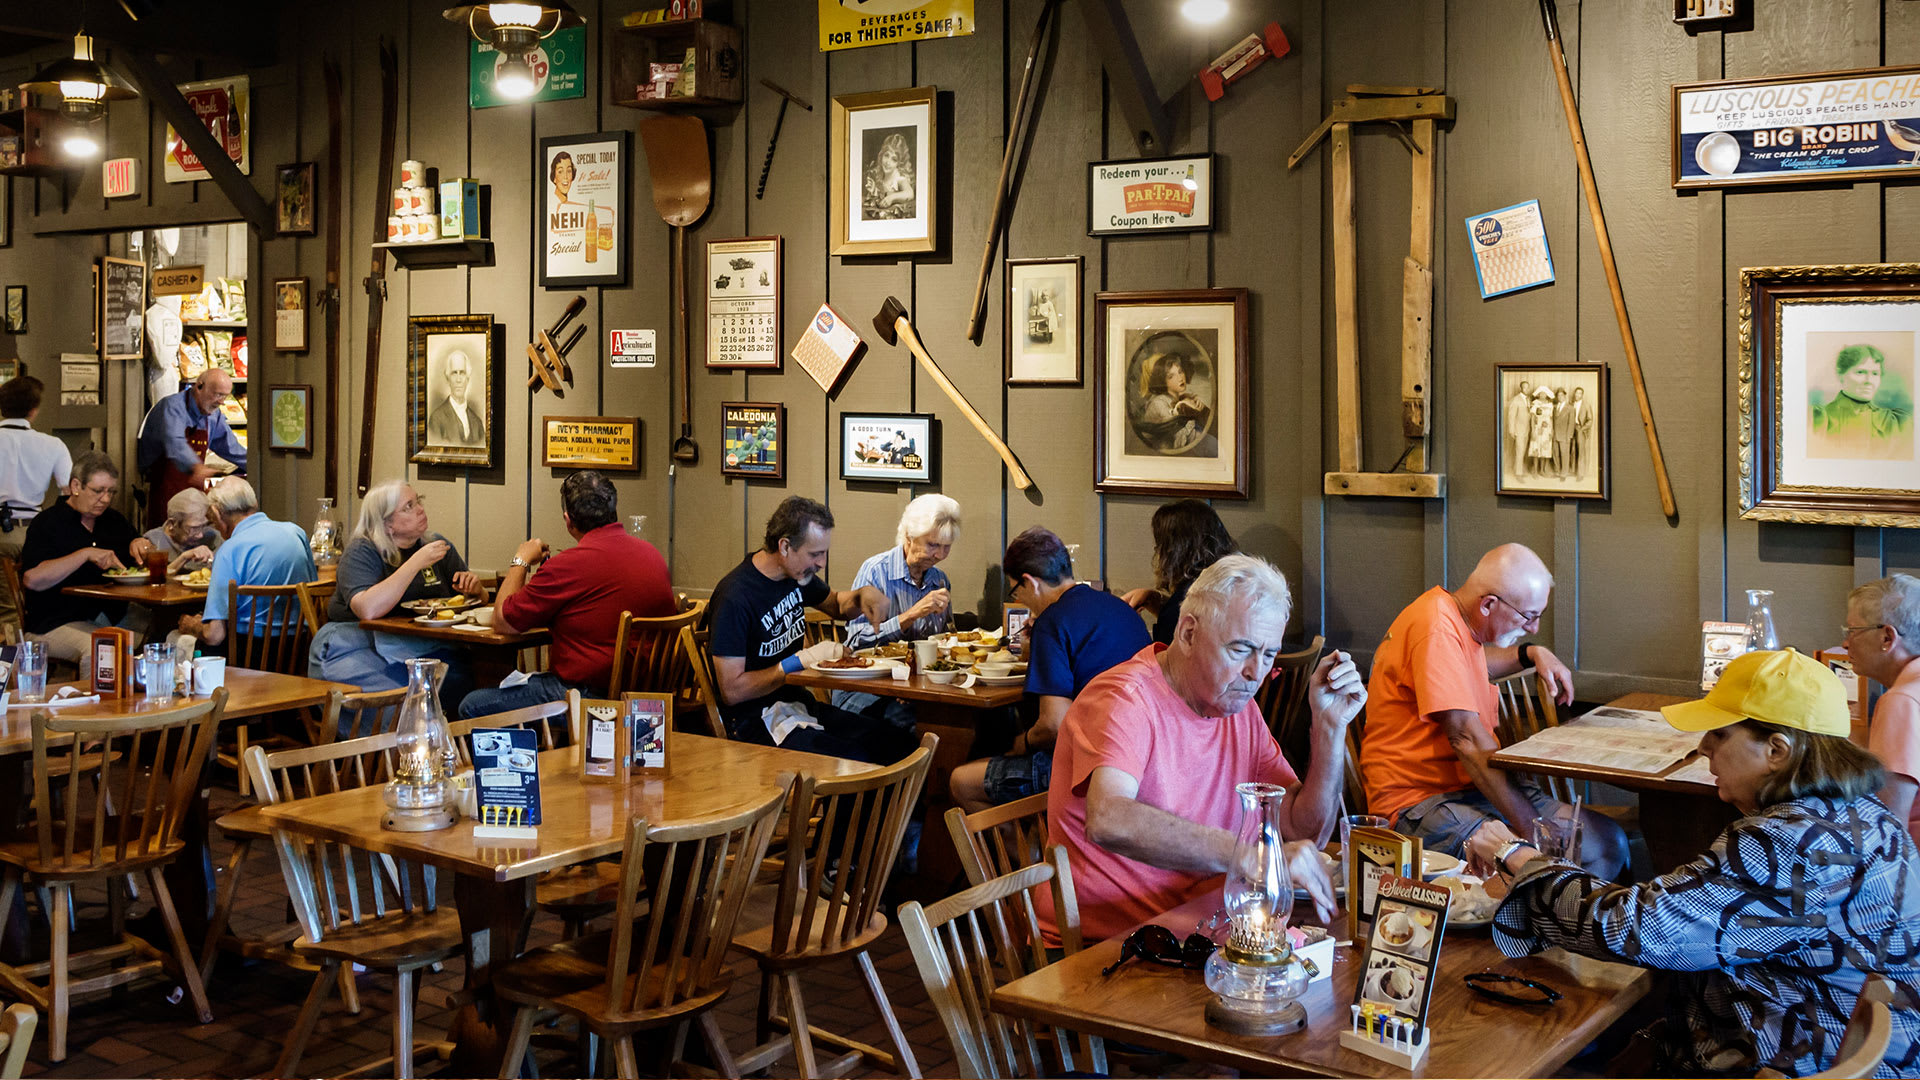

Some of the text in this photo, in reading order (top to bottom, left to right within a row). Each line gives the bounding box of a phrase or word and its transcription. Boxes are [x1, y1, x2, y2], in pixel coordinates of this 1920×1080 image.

[861, 11, 927, 27] BEVERAGES
[829, 32, 852, 45] FOR
[478, 43, 494, 53] DRIN
[1689, 86, 1815, 115] LUSCIOUS
[1717, 112, 1746, 121] KEEP
[1752, 107, 1812, 119] LUSCIOUS
[1816, 103, 1869, 114] PEACHES
[1873, 100, 1916, 110] HANDY
[1717, 120, 1745, 129] GIFTS
[1764, 116, 1806, 126] FRIENDS
[1820, 113, 1855, 123] TREATS
[1753, 122, 1877, 148] BIG ROBIN
[183, 154, 201, 166] ROO
[576, 150, 617, 165] SPECIAL TODAY
[1749, 151, 1772, 160] "THE
[1773, 150, 1808, 159] CREAM
[1826, 147, 1845, 155] THE
[1848, 145, 1880, 154] CROP"
[108, 160, 130, 195] EXIT
[1100, 167, 1141, 180] Redeem
[550, 211, 584, 230] NEHI
[1110, 212, 1176, 229] Coupon Here
[1475, 218, 1497, 237] 500
[550, 241, 583, 256] Special
[157, 274, 189, 287] CASHIER
[720, 353, 738, 361] 29 30
[727, 411, 777, 422] CALEDONIA
[557, 424, 624, 436] IVEY'S PHARMACY
[571, 436, 594, 444] KODAKS,
[596, 437, 611, 445] WALL
[613, 437, 631, 445] PAPER
[761, 611, 775, 631] IN
[1380, 878, 1414, 898] Sweet
[1412, 886, 1448, 907] CLASSICS
